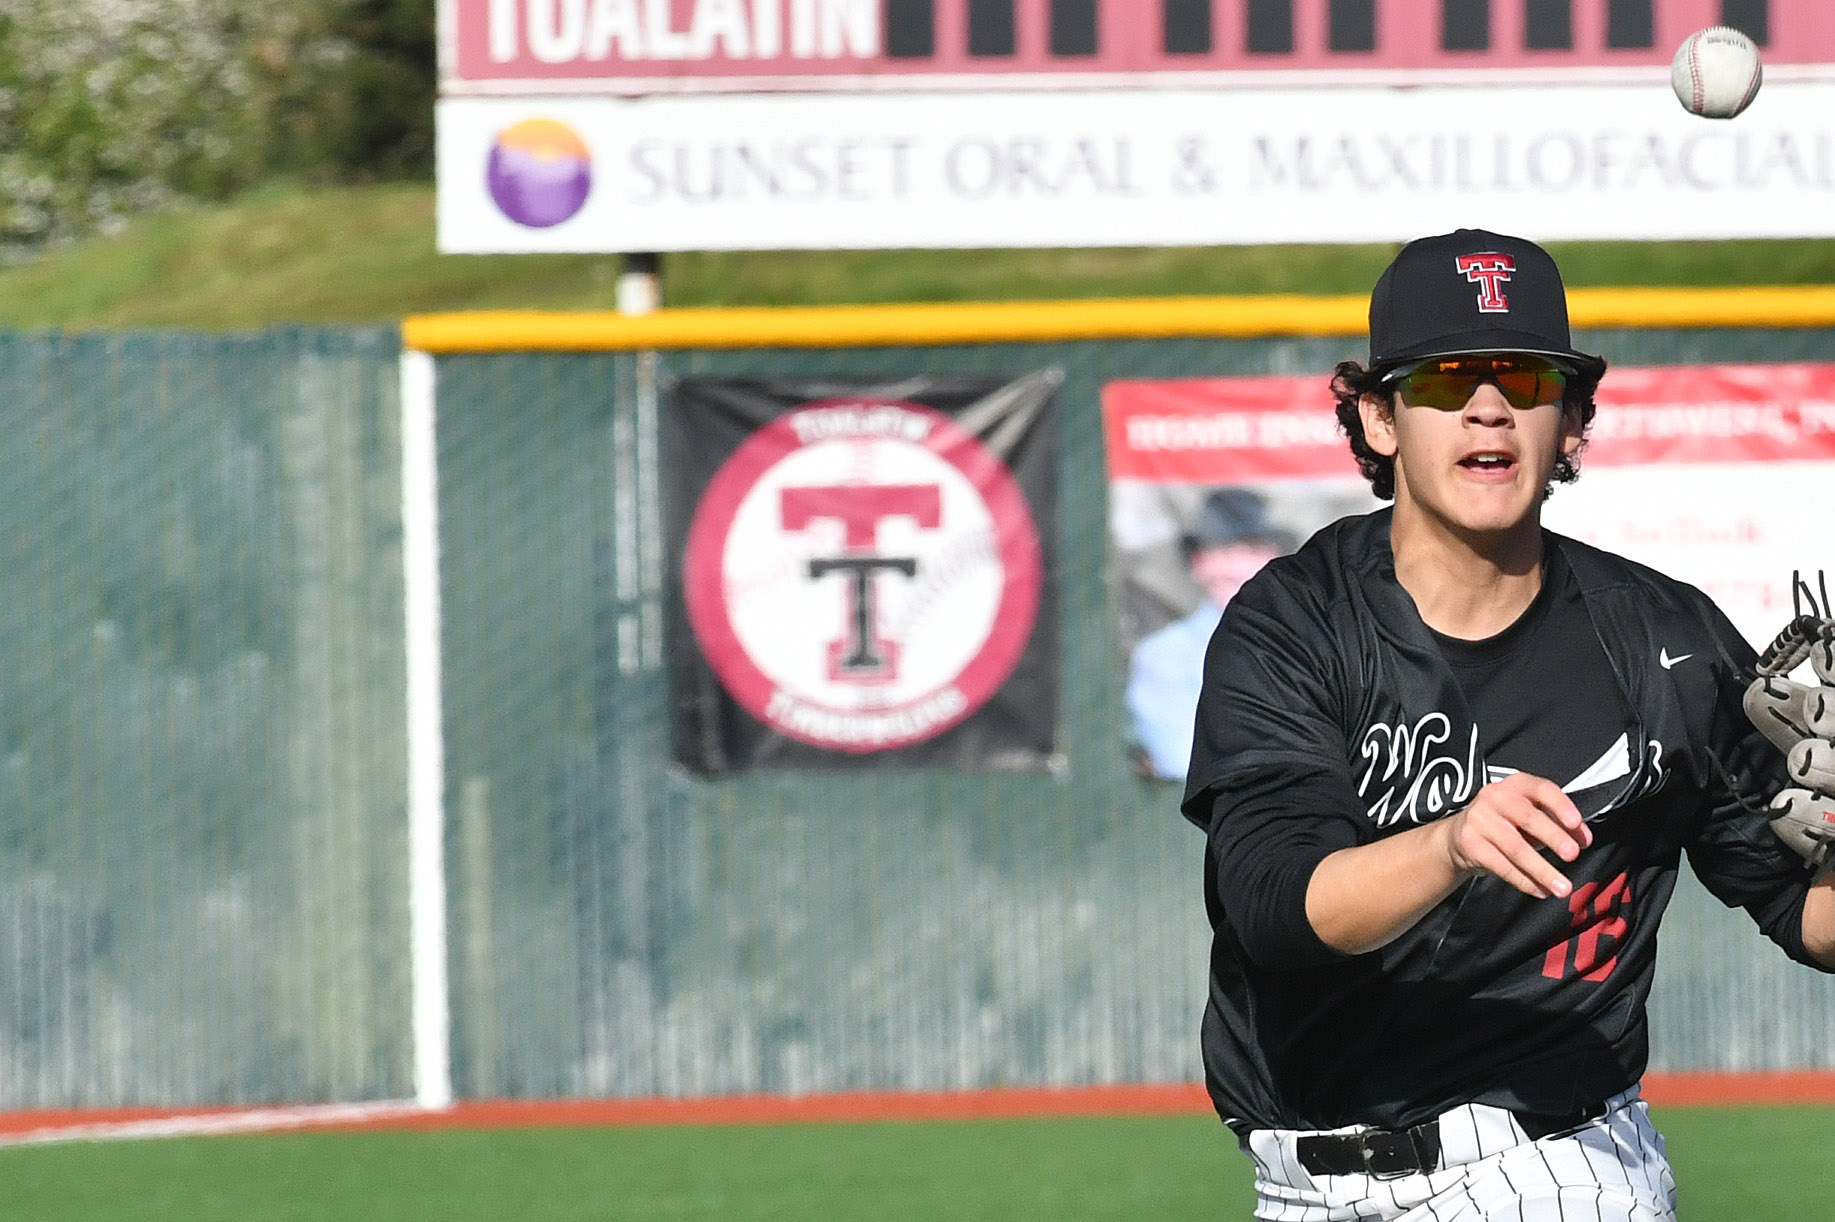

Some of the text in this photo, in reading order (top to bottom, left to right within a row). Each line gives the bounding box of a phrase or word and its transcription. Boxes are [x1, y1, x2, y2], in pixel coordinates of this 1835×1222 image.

[628, 136, 922, 204] SUNSET
[943, 134, 1150, 200] ORAL
[1170, 133, 1220, 197] &
